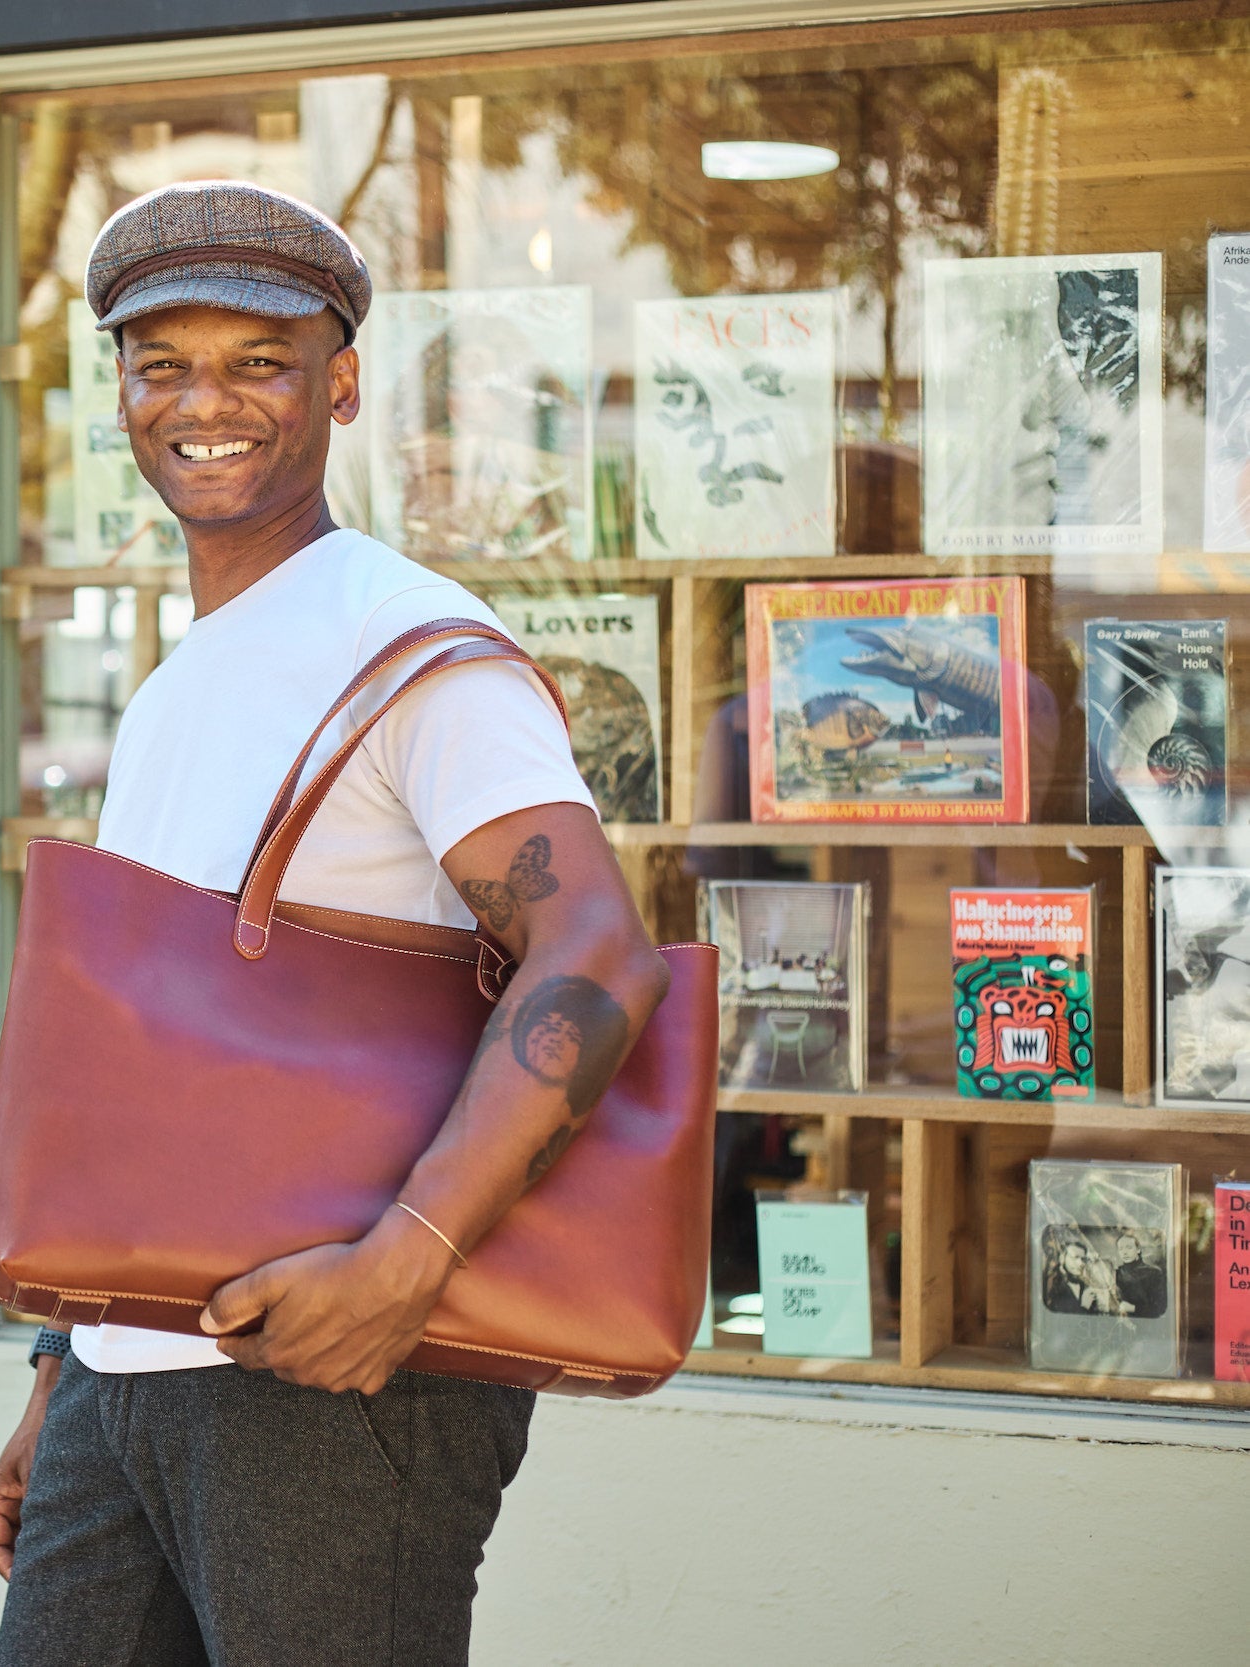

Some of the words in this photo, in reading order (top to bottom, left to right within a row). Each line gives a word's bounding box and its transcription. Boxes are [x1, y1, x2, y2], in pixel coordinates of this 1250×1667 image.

[1224, 256, 1250, 265] Ande
[942, 533, 1003, 547] ROBERT
[769, 589, 899, 618] AMERICAN
[909, 582, 1011, 617] BEAUTY
[524, 612, 633, 635] Lovers
[1097, 629, 1122, 640] Gary
[1124, 629, 1161, 640] Snyder
[1181, 628, 1209, 638] Earth
[1177, 643, 1213, 654] House
[1183, 659, 1209, 669] Hold
[879, 804, 896, 817] BY
[900, 804, 941, 817] DAVID
[944, 804, 1005, 817] GRAHAM
[954, 898, 1073, 926] Hallucinogens
[956, 924, 981, 940] AND
[982, 921, 1084, 942] Shamanism
[1230, 1215, 1244, 1231] in
[1229, 1262, 1249, 1275] An
